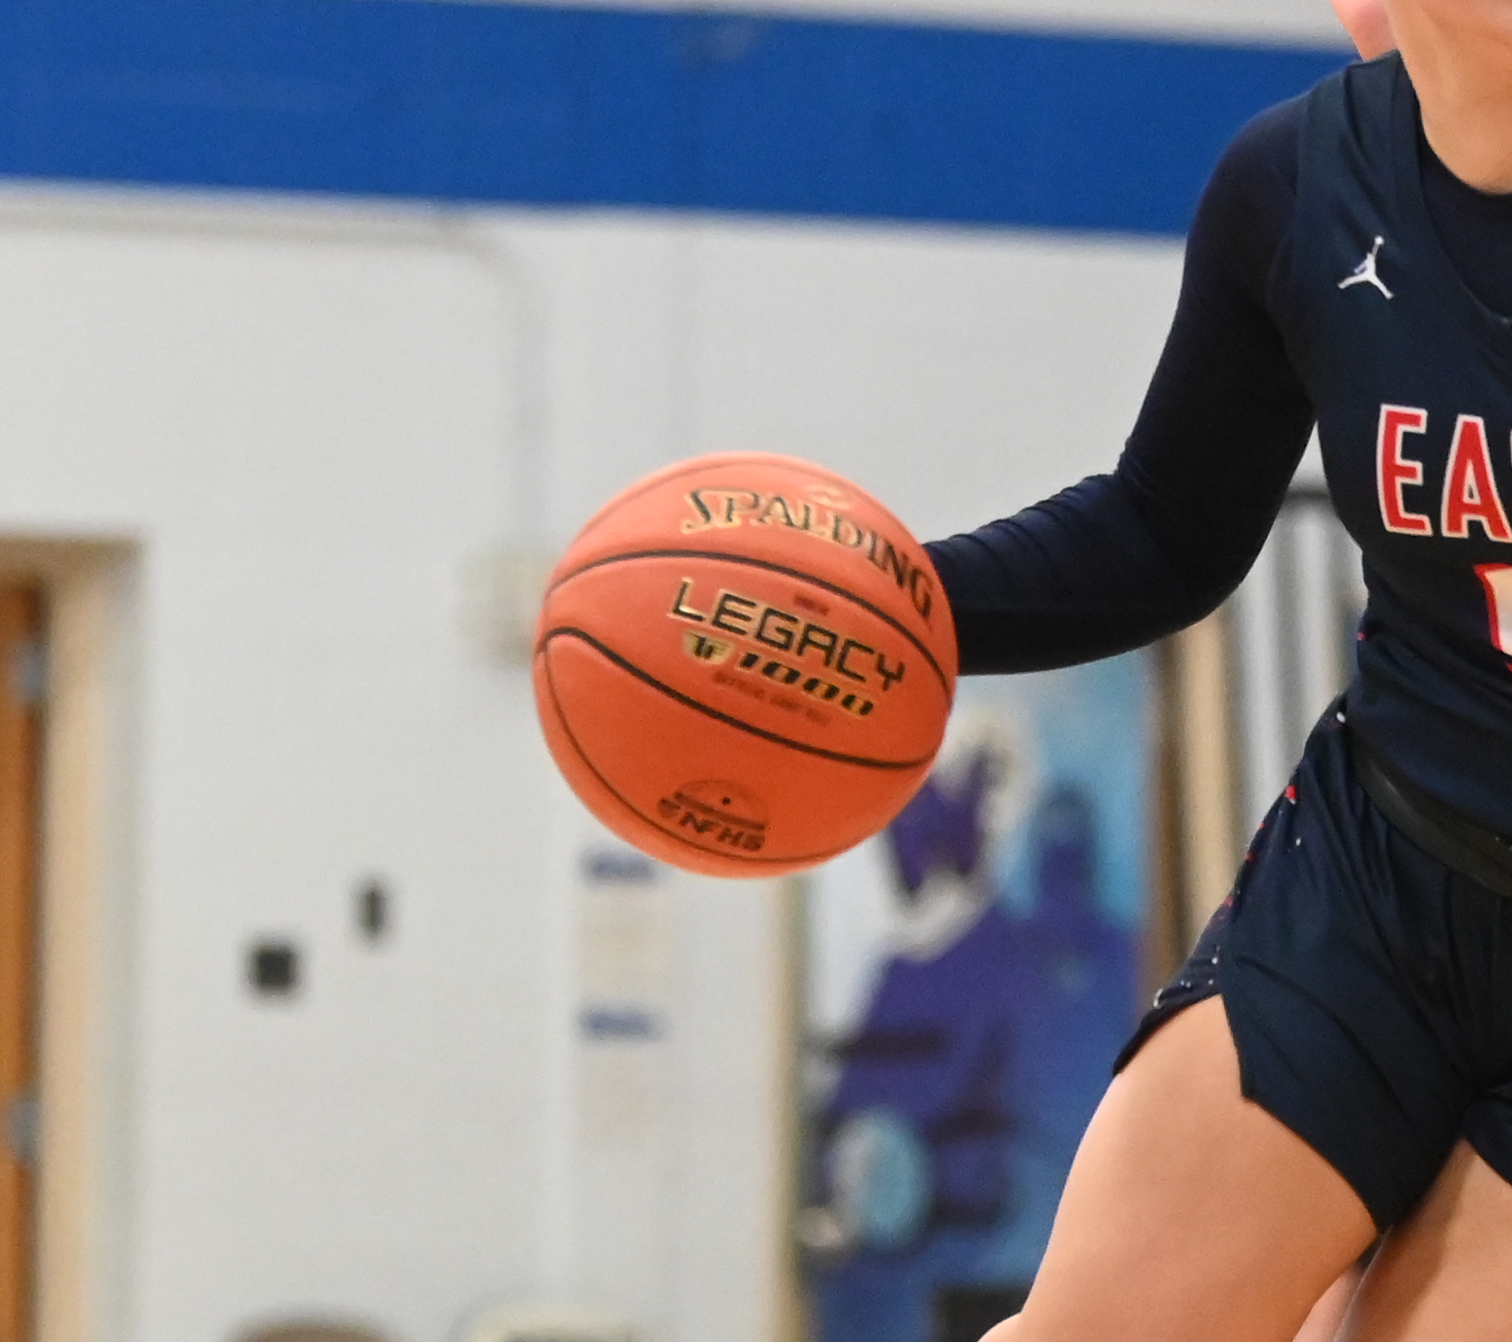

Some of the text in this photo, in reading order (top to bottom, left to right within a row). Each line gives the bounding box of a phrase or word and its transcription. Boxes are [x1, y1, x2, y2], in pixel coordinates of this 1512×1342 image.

[681, 485, 935, 620] SPALDING
[667, 576, 906, 692] LEGACY
[736, 651, 875, 719] 1000
